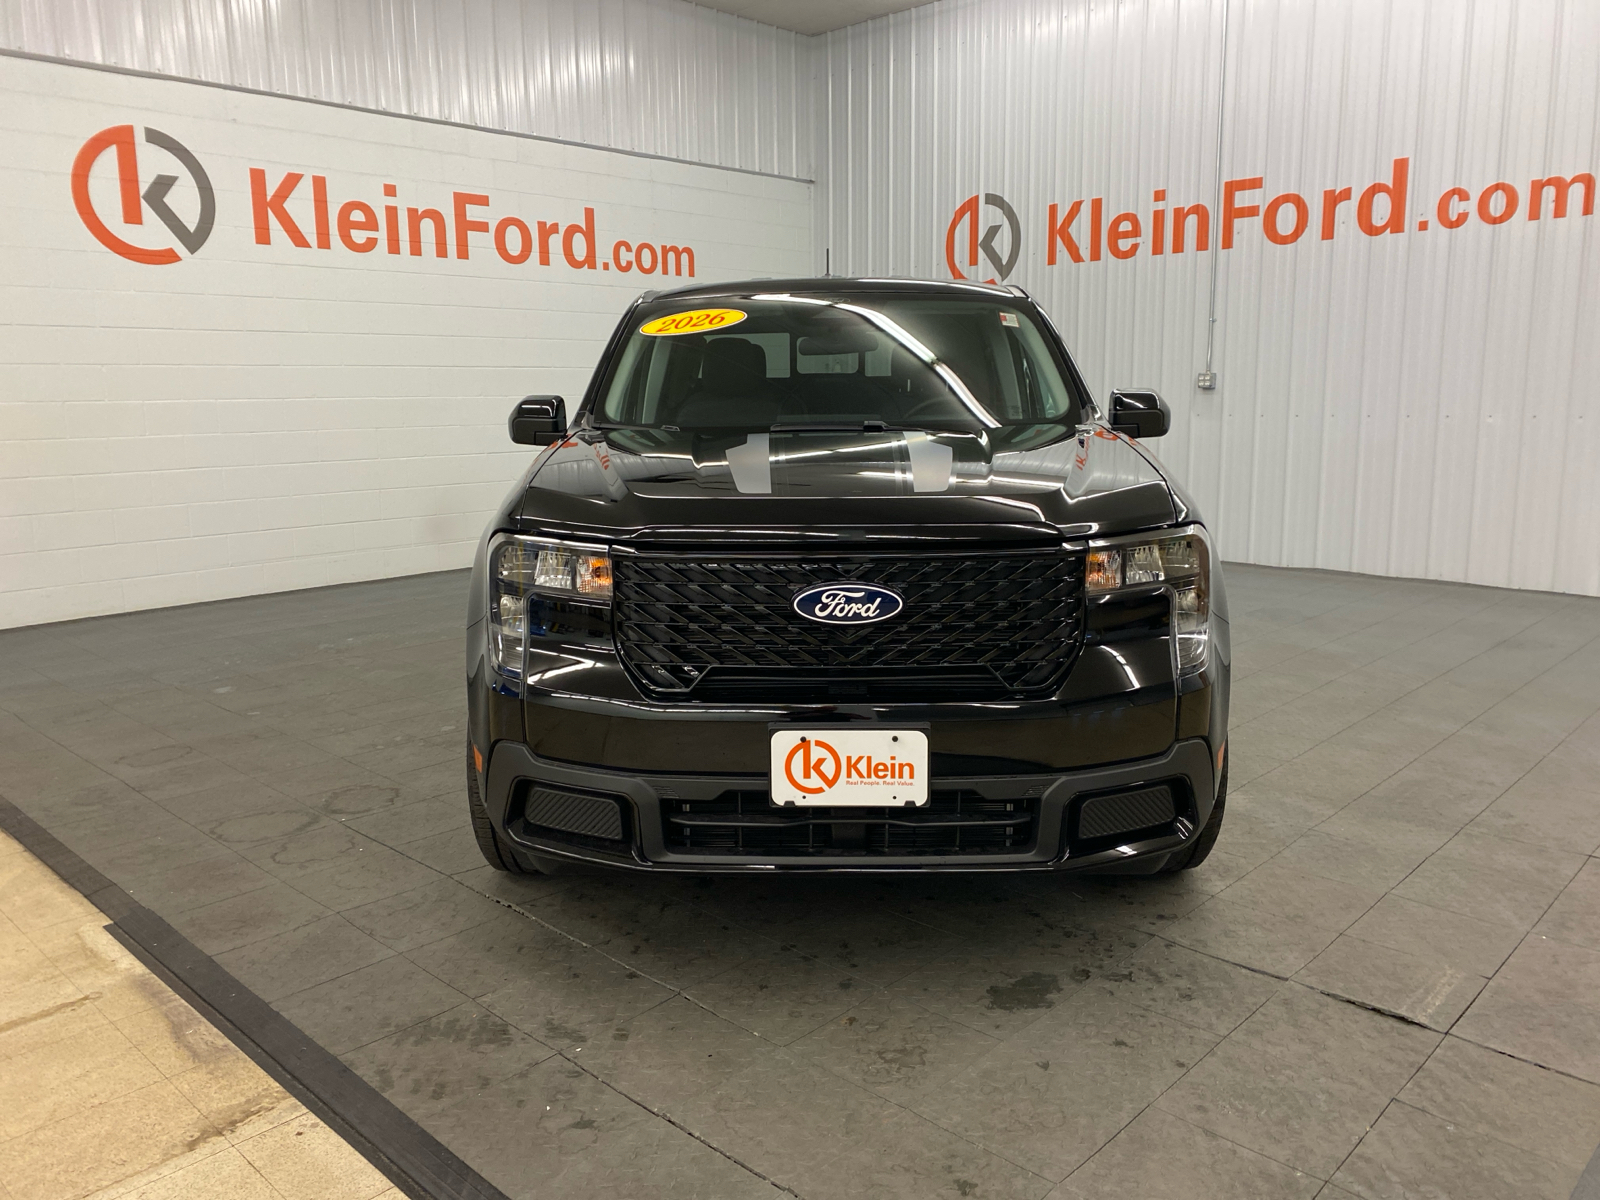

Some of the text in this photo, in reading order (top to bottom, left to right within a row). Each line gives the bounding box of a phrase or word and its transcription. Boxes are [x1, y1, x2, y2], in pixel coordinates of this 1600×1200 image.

[249, 168, 695, 277] KleinFord.com
[1047, 157, 1596, 266] KleinFord.com
[656, 311, 731, 333] 2026
[815, 590, 881, 617] Ford
[846, 756, 915, 780] Klein
